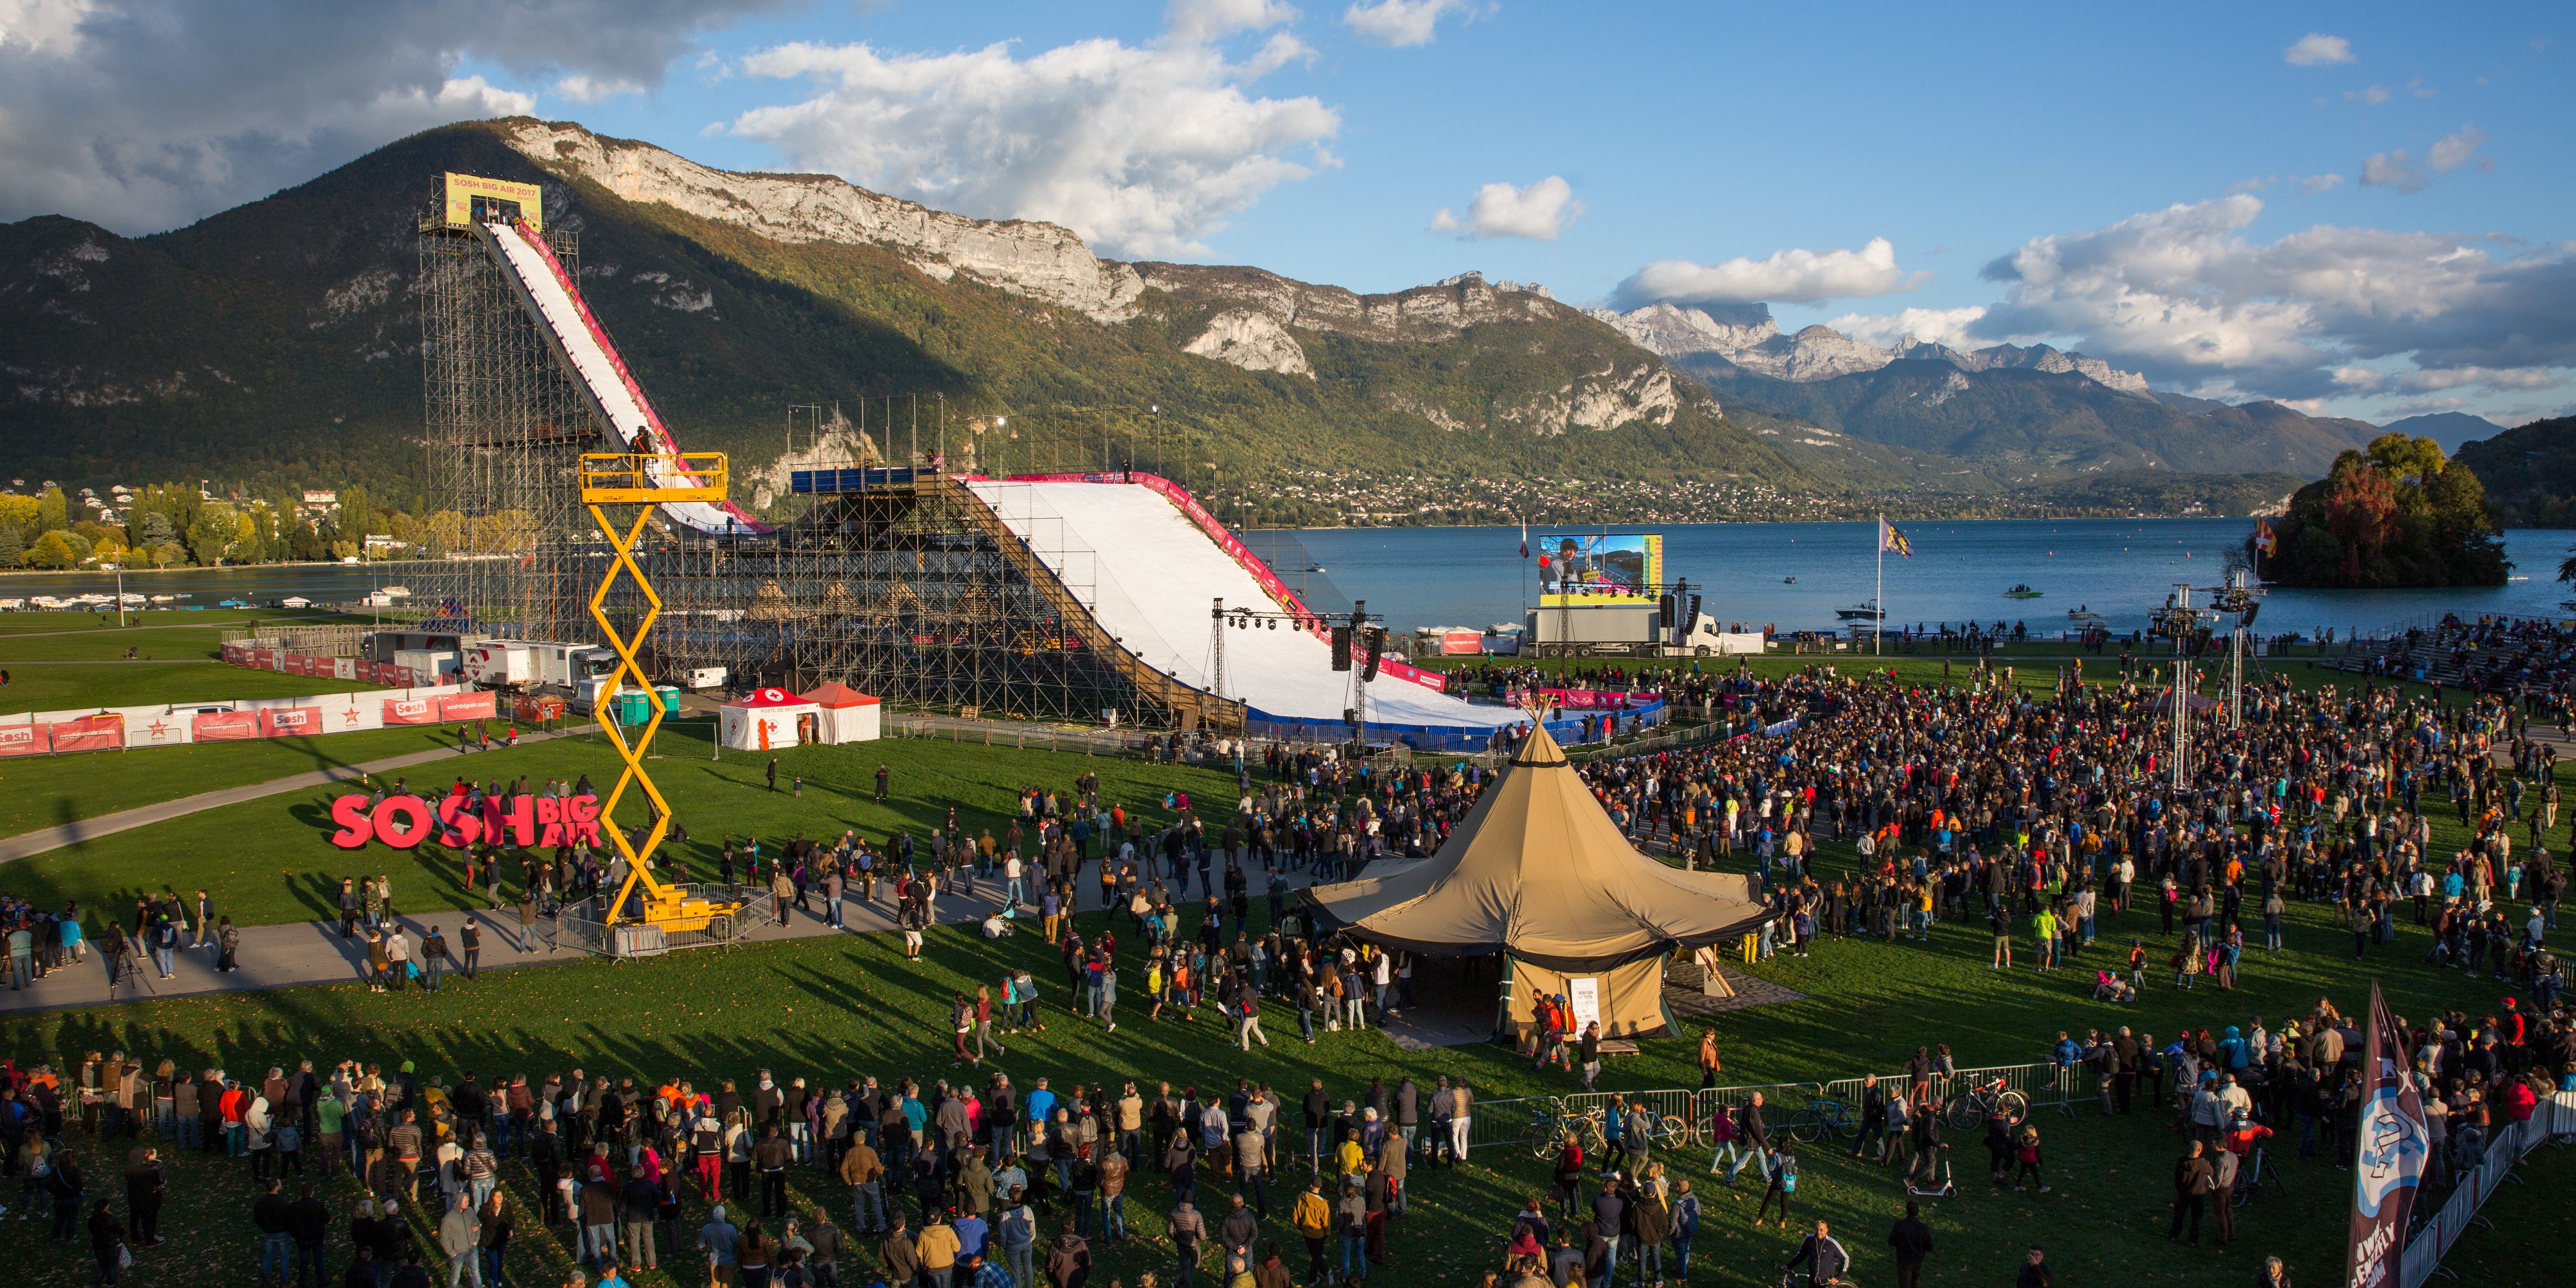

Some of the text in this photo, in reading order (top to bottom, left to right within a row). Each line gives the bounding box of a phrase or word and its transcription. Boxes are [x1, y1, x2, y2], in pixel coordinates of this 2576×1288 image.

[454, 178, 536, 197] SOSH BIG AIR 2017
[1421, 677, 1439, 685] NISSAN
[399, 703, 424, 713] Sosh
[447, 702, 490, 710] soshbigair.com
[276, 714, 304, 724] Sosh
[537, 794, 600, 824] BIG
[331, 794, 534, 848] SOSH
[540, 820, 602, 848] AIR
